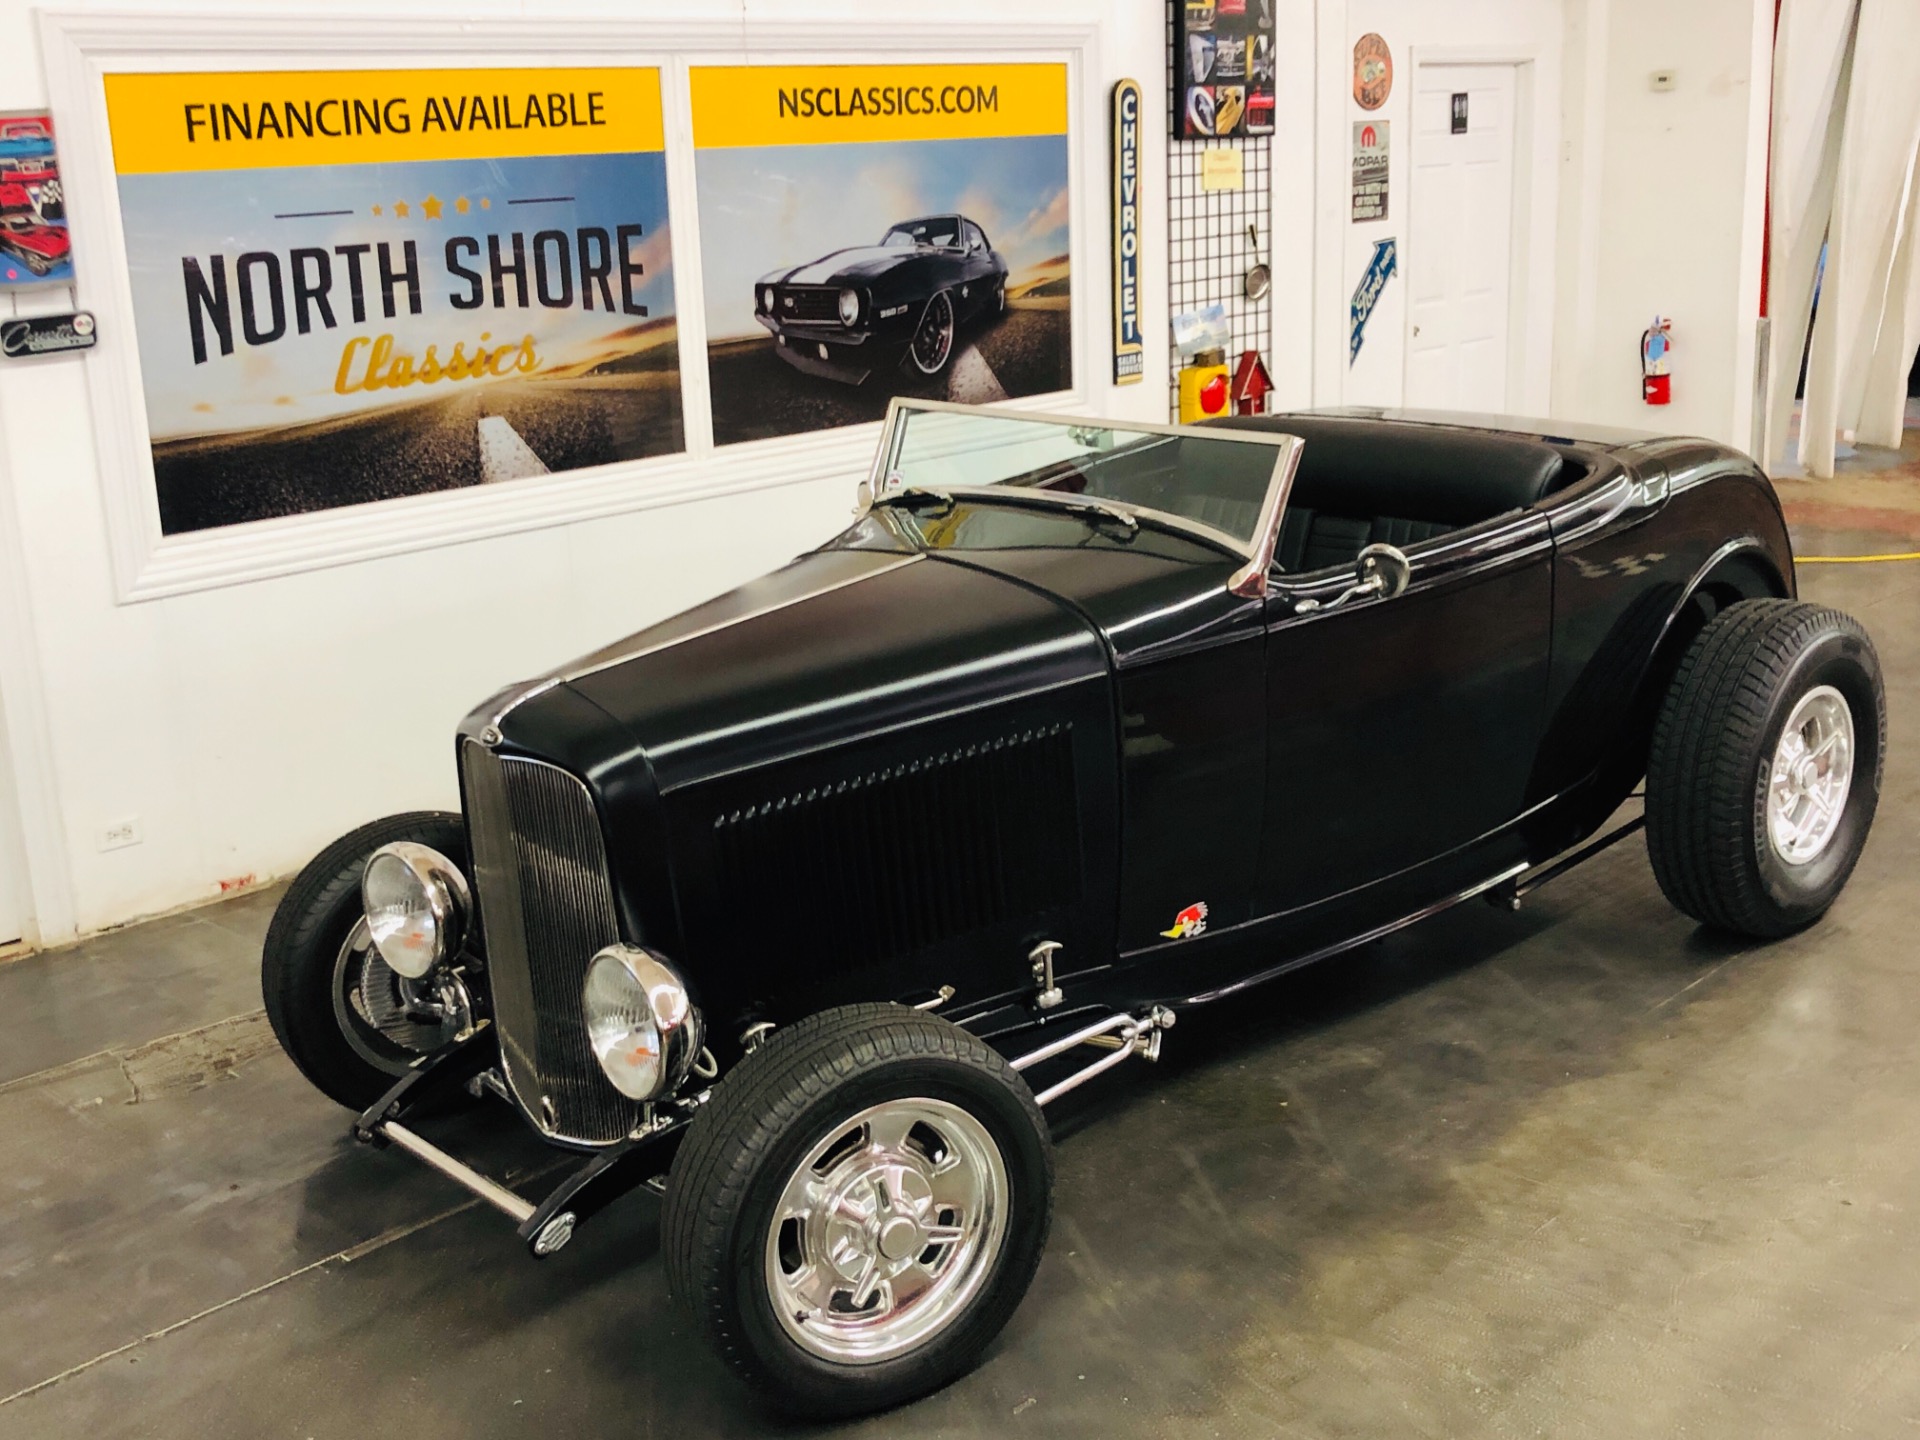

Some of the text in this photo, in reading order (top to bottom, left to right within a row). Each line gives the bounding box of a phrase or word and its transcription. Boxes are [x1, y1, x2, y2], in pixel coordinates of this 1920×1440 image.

[184, 92, 606, 143] FINANCING AVAILABLE
[778, 86, 998, 118] NSCLASSICS.COM
[1122, 94, 1137, 339] CHEVROLET
[182, 223, 648, 365] NORTH SHORE
[334, 331, 544, 395] Classics
